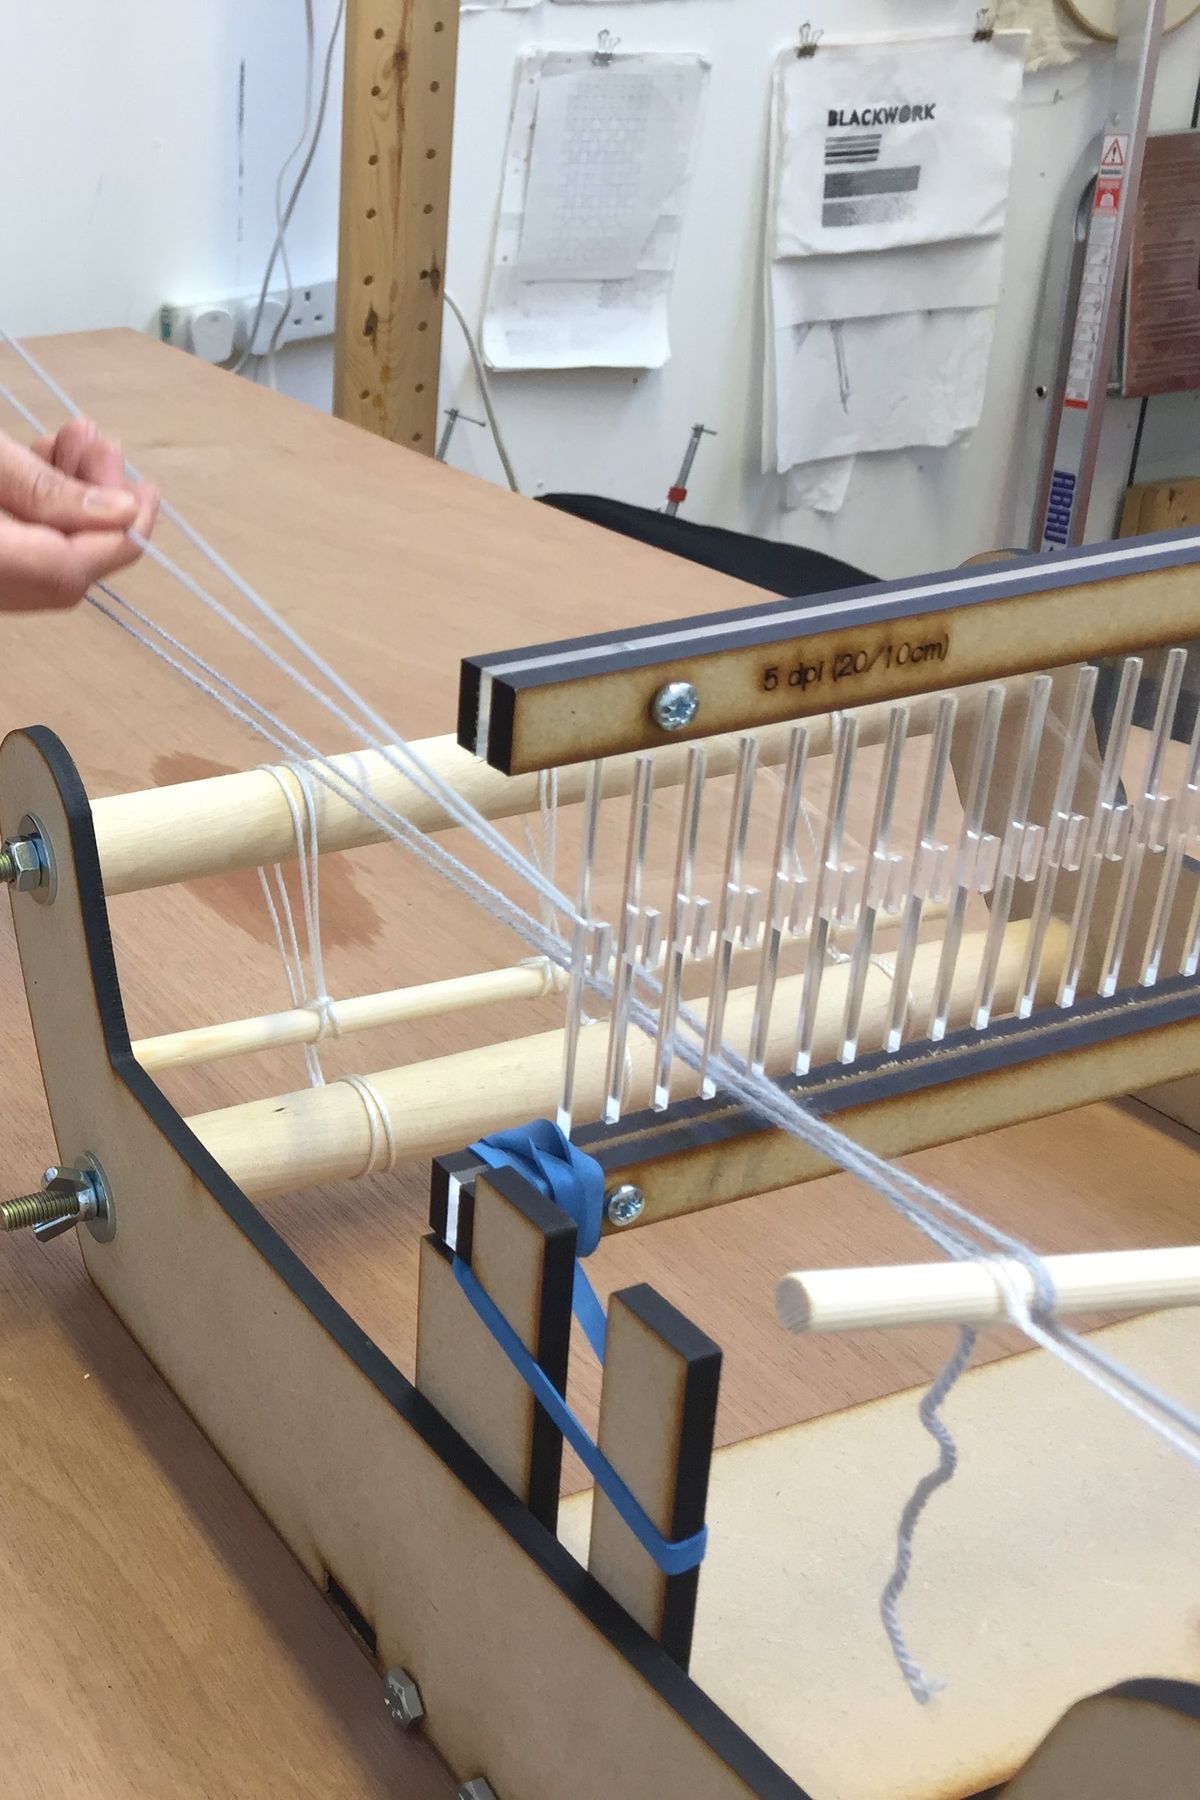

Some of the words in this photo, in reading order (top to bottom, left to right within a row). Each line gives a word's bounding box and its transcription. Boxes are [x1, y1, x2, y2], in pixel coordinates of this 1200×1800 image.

[827, 102, 936, 127] BLACKWORK
[1044, 470, 1076, 545] ABRU
[763, 666, 779, 692] 5
[832, 633, 949, 683] (20/10cm)
